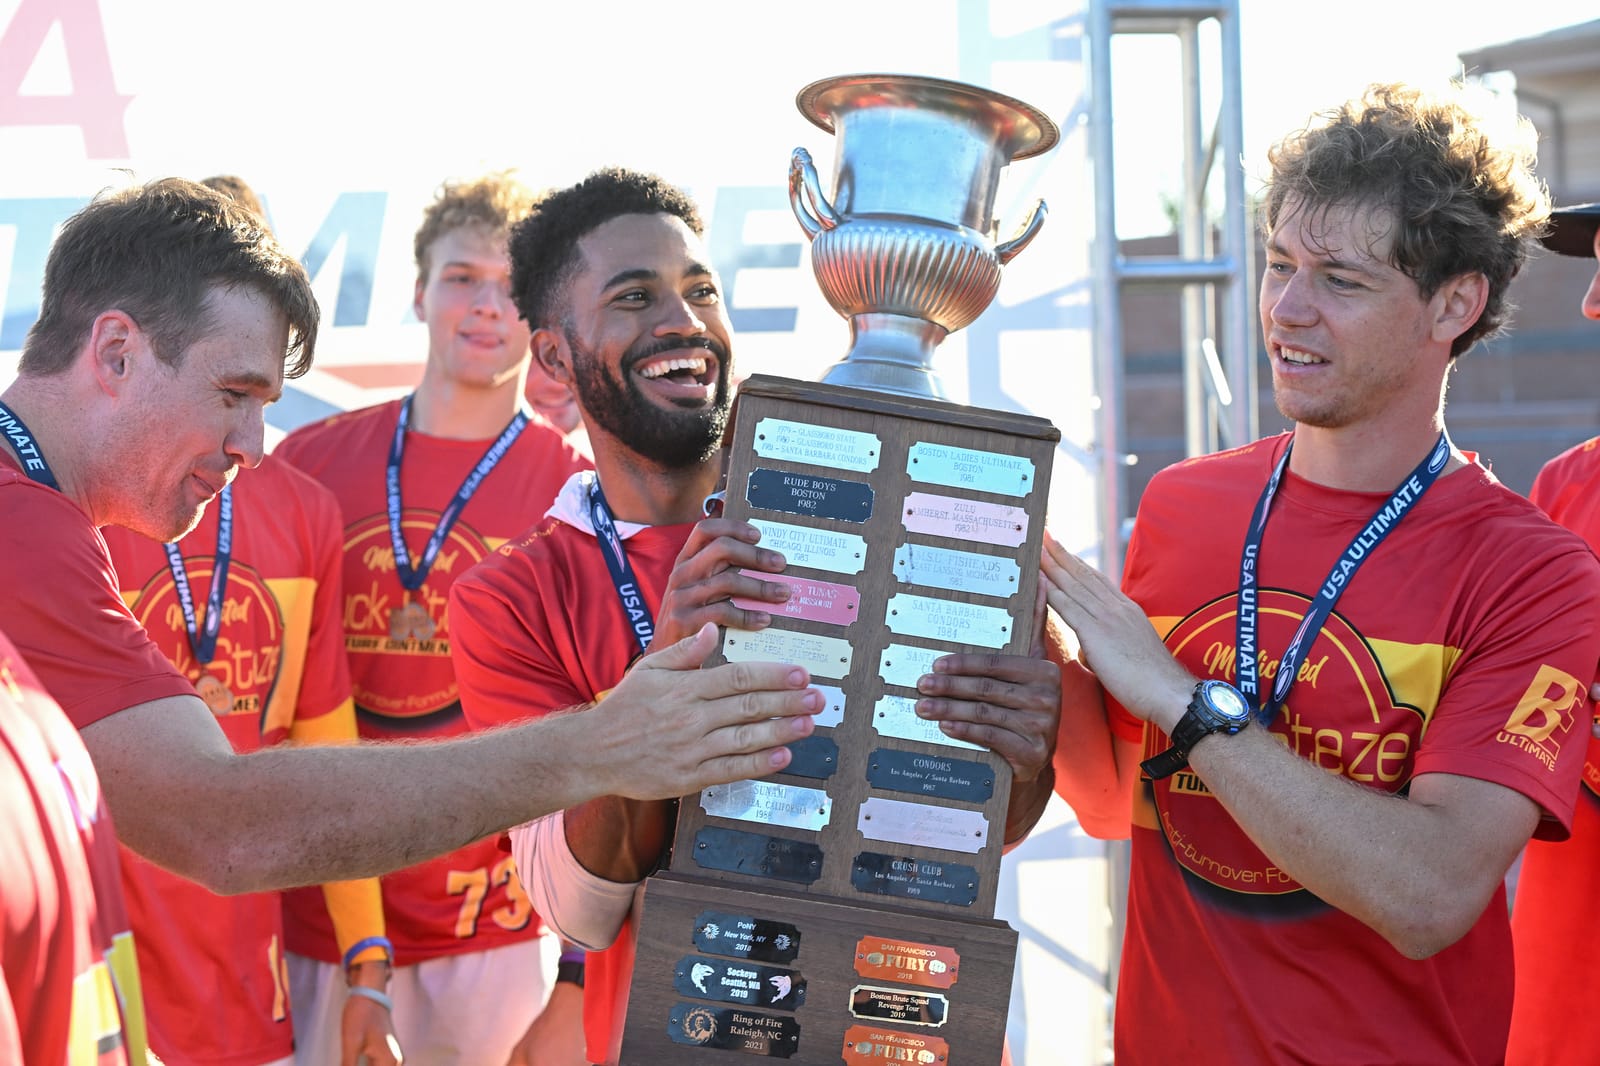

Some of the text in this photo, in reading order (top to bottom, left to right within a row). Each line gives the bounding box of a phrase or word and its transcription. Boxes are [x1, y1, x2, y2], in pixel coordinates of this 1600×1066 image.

[836, 432, 857, 443] STATE
[781, 445, 803, 456] SANTA
[804, 448, 836, 460] BARBARA
[835, 443, 856, 453] STATE
[918, 447, 1023, 470] BOSTON LADIES ULTIMATE
[953, 462, 984, 473] BOSTON
[783, 476, 837, 491] RUDE BOYS
[791, 487, 826, 500] BOSTON
[797, 499, 817, 509] 1982
[953, 503, 977, 514] ZULU
[761, 526, 849, 549] WINDY CITY ULTIMATE
[1322, 474, 1423, 601] USA ULTIMATE
[804, 544, 836, 557] ILLINOIS
[966, 568, 1000, 582] MICHIGAN
[619, 583, 644, 622] USA
[911, 599, 988, 620] SANTA BARBARA
[927, 614, 971, 629] CONDORS
[1239, 544, 1258, 695] USA ULTIMATE
[937, 626, 958, 639] 1984
[1496, 731, 1556, 772] ULTIMATE
[913, 758, 952, 772] CONDORS
[902, 769, 923, 779] Angeles
[931, 774, 948, 783] Santa
[949, 776, 971, 786] Barbara
[891, 860, 943, 876] CRUSH CLUB
[874, 871, 884, 879] Los
[886, 873, 908, 882] Angeles
[916, 877, 932, 886] Santa
[446, 855, 532, 939] 73
[737, 921, 757, 930] PoNY
[724, 930, 738, 939] New
[881, 943, 937, 957] SAN FRANCISCO
[885, 953, 929, 972] FURY
[727, 967, 758, 979] Sockeye
[870, 991, 930, 1006] Boston Brute Squad
[878, 1001, 920, 1013] Revenge Tour
[732, 1013, 783, 1028] Ring of Fire
[890, 1011, 906, 1019] 2019
[767, 1029, 783, 1041] NC
[870, 1033, 926, 1047] SAN FRANCISCO
[744, 1040, 764, 1050] 2021
[874, 1043, 917, 1062] FURY
